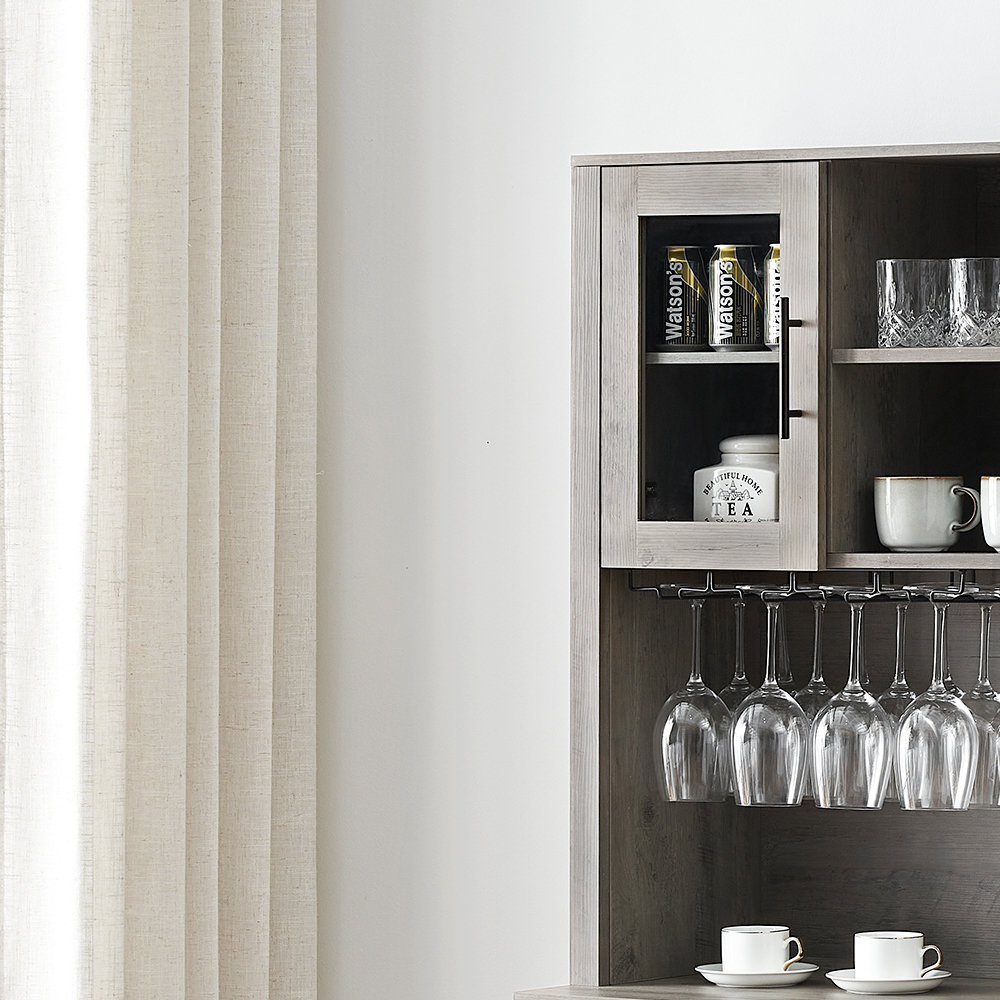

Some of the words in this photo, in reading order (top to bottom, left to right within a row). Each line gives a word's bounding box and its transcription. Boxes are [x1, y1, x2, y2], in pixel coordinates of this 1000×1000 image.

[665, 261, 683, 341] Watson's
[719, 261, 734, 341] Watson's
[703, 472, 741, 496] BEAUTIFUL
[741, 474, 764, 496] HOME
[711, 502, 754, 516] TEA
